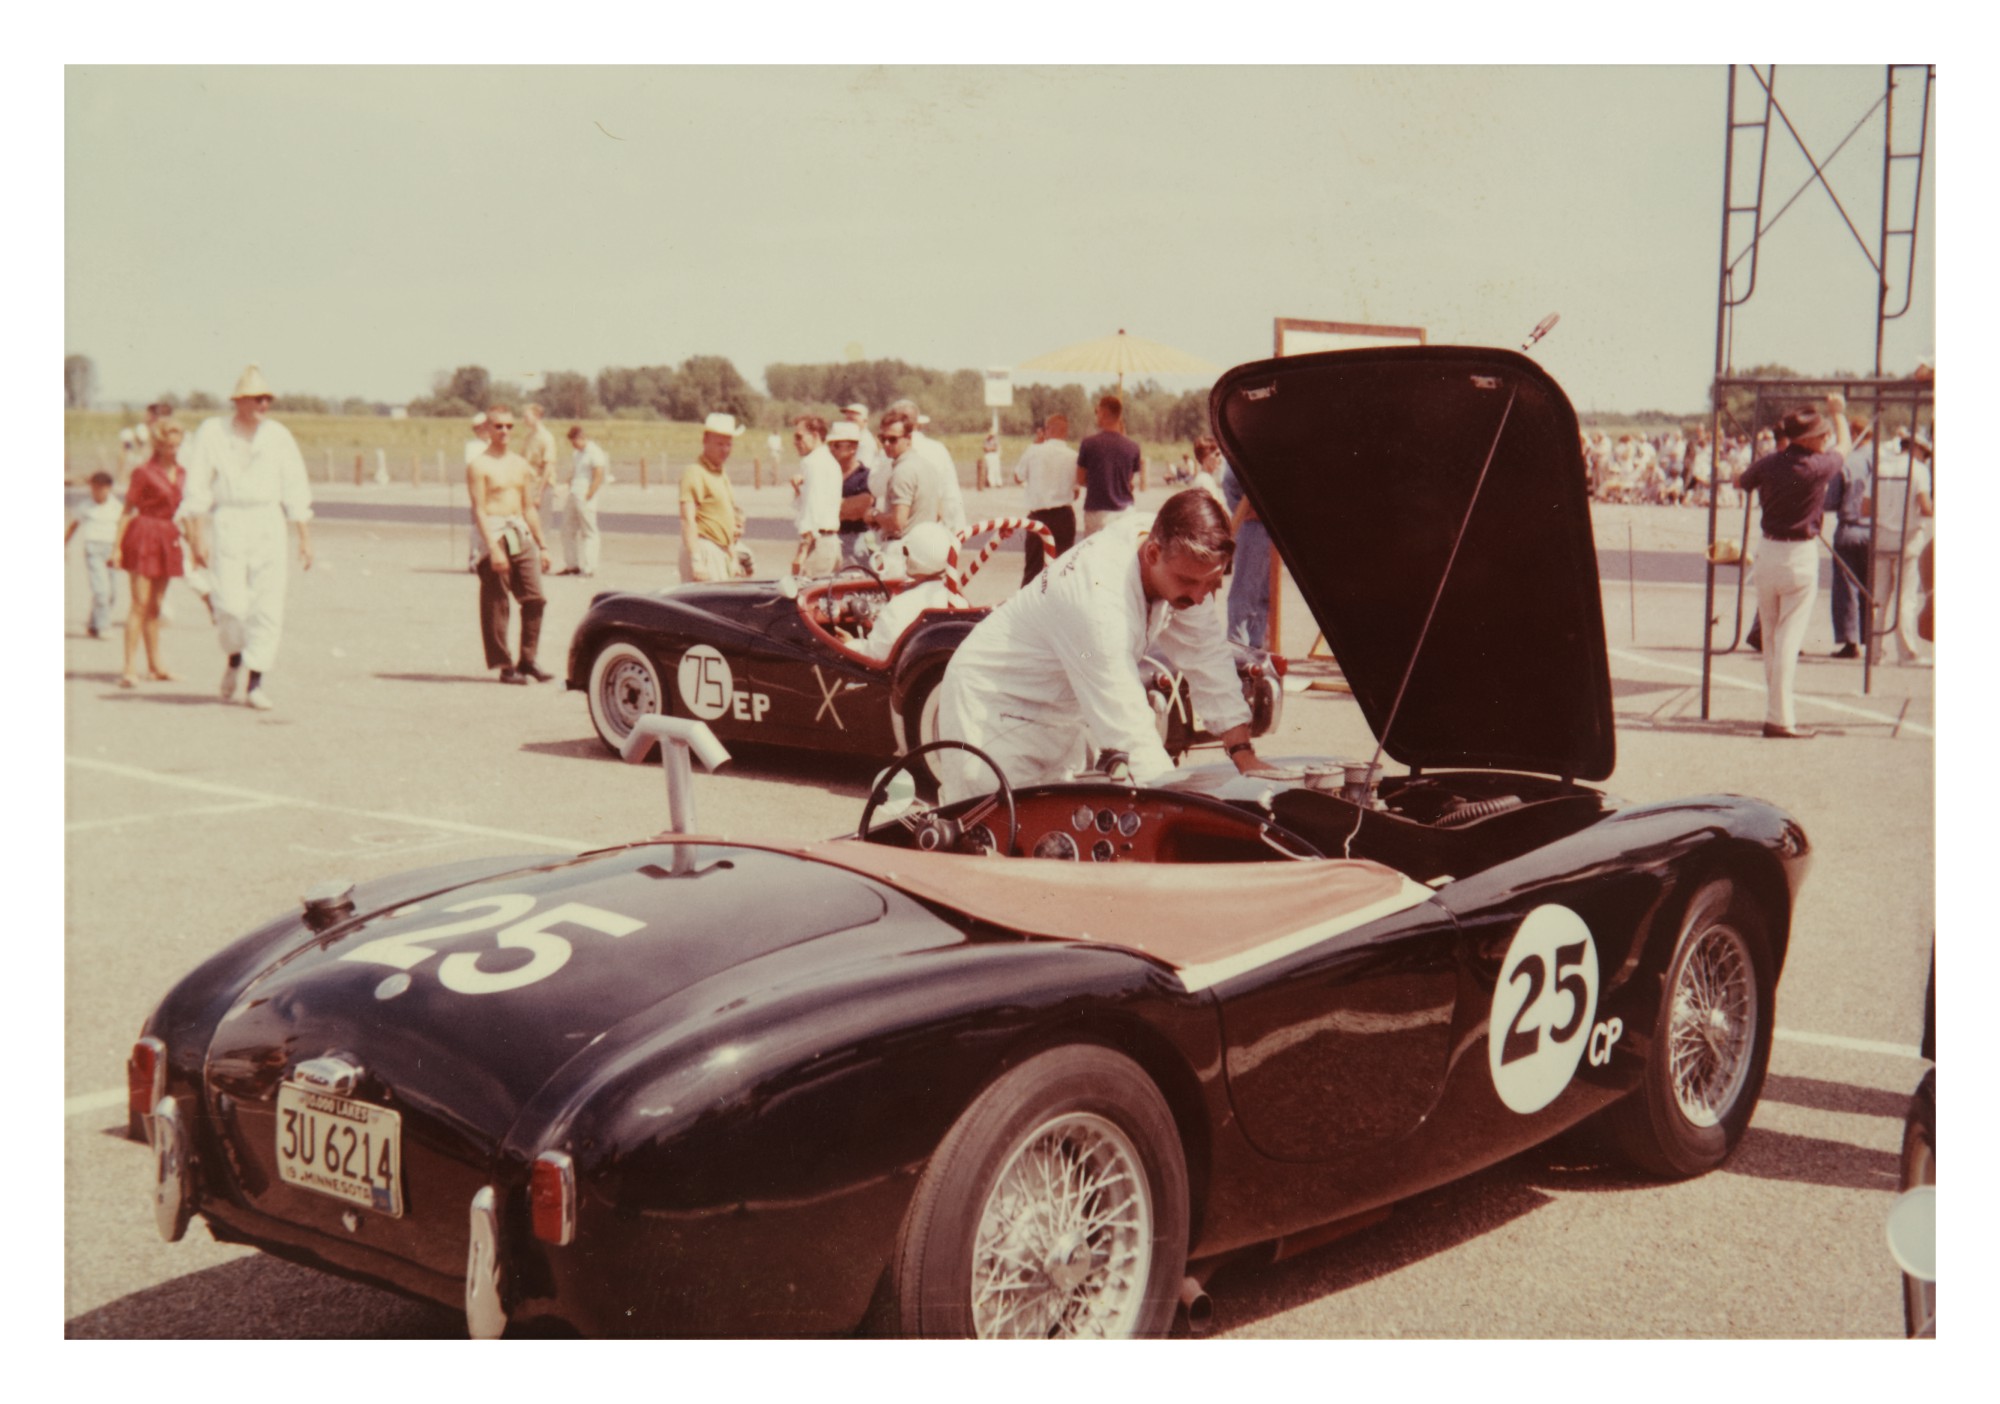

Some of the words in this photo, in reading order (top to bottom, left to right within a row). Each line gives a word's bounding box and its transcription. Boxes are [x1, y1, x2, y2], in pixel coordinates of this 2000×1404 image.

[685, 654, 725, 710] 75
[733, 691, 771, 722] EP
[337, 893, 648, 994] 25
[1501, 938, 1588, 1067] 25
[1588, 1016, 1624, 1067] CP
[336, 1100, 368, 1122] LAKES
[281, 1108, 315, 1165] 3U
[324, 1123, 393, 1190] 6214
[302, 1170, 371, 1199] MINNESOTA
